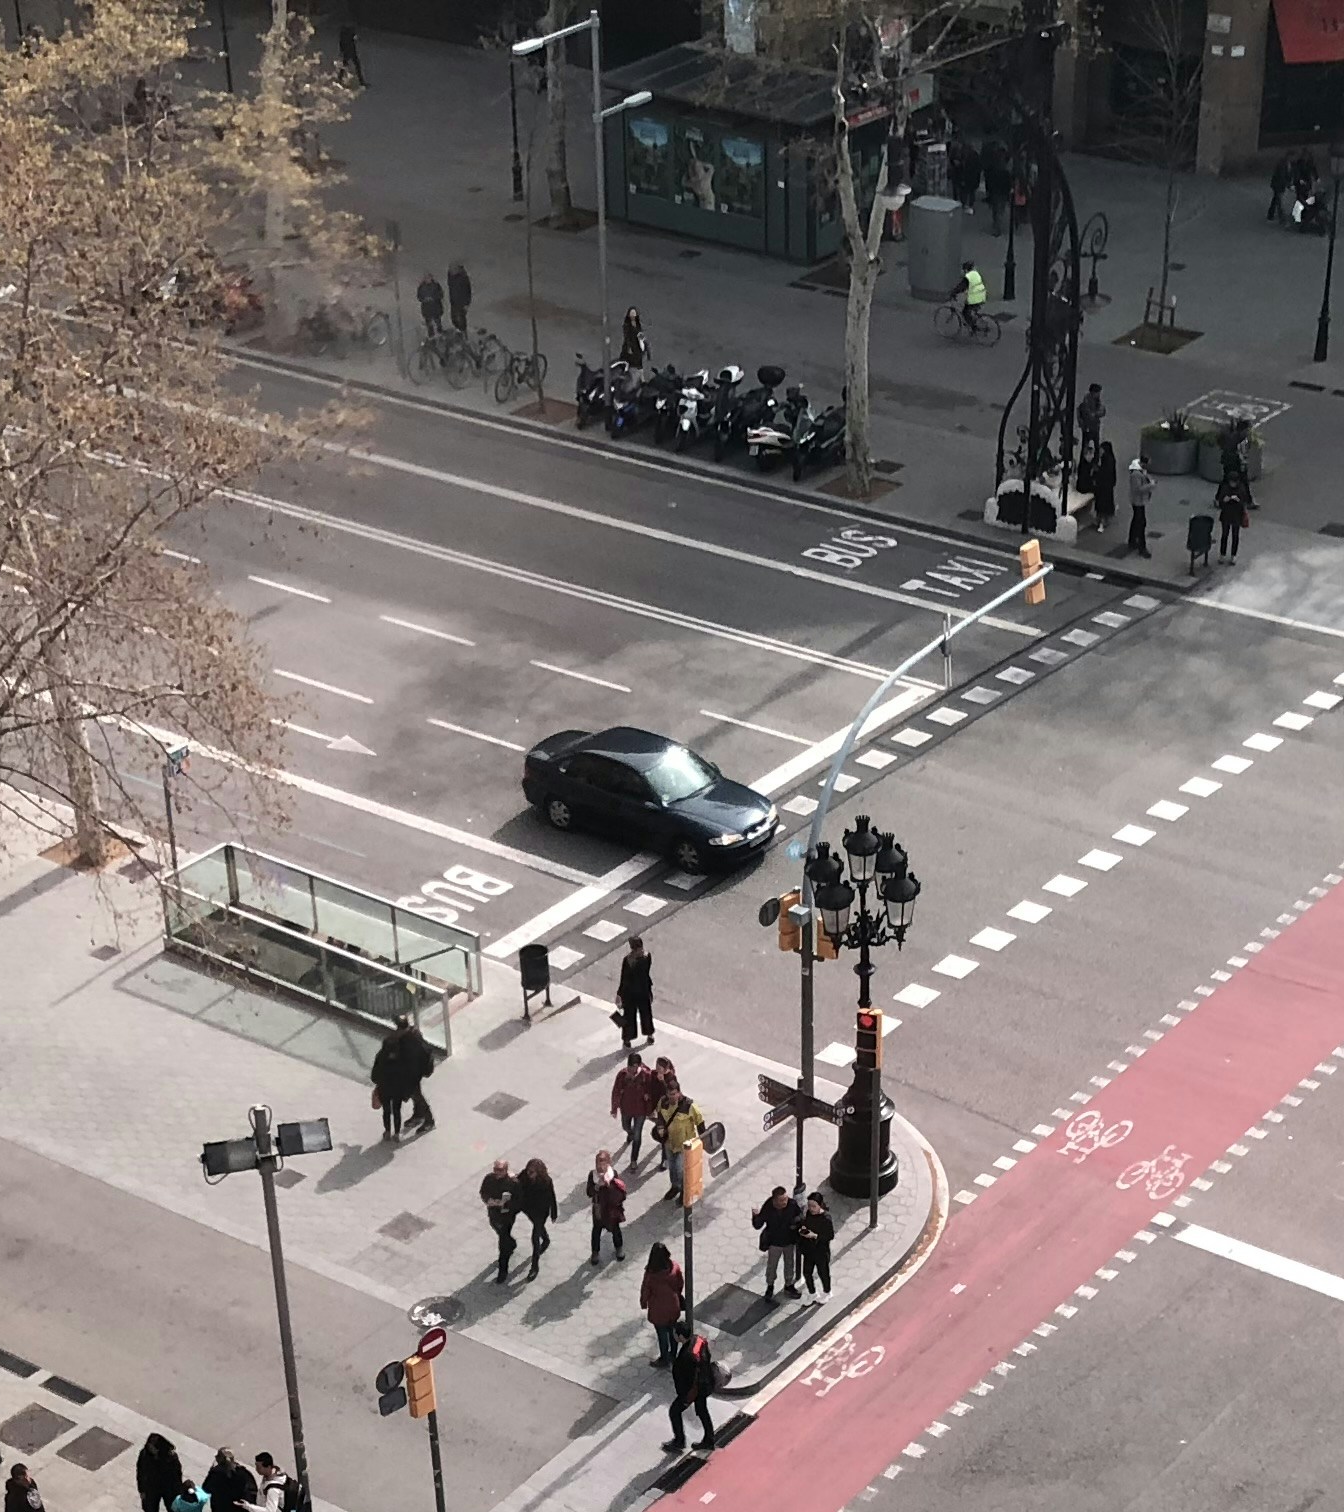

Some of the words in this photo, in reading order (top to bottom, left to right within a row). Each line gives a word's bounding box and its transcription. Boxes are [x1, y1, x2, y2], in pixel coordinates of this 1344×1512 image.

[801, 529, 898, 569] BUS
[899, 556, 1009, 597] TAXI
[394, 864, 514, 925] BUS
